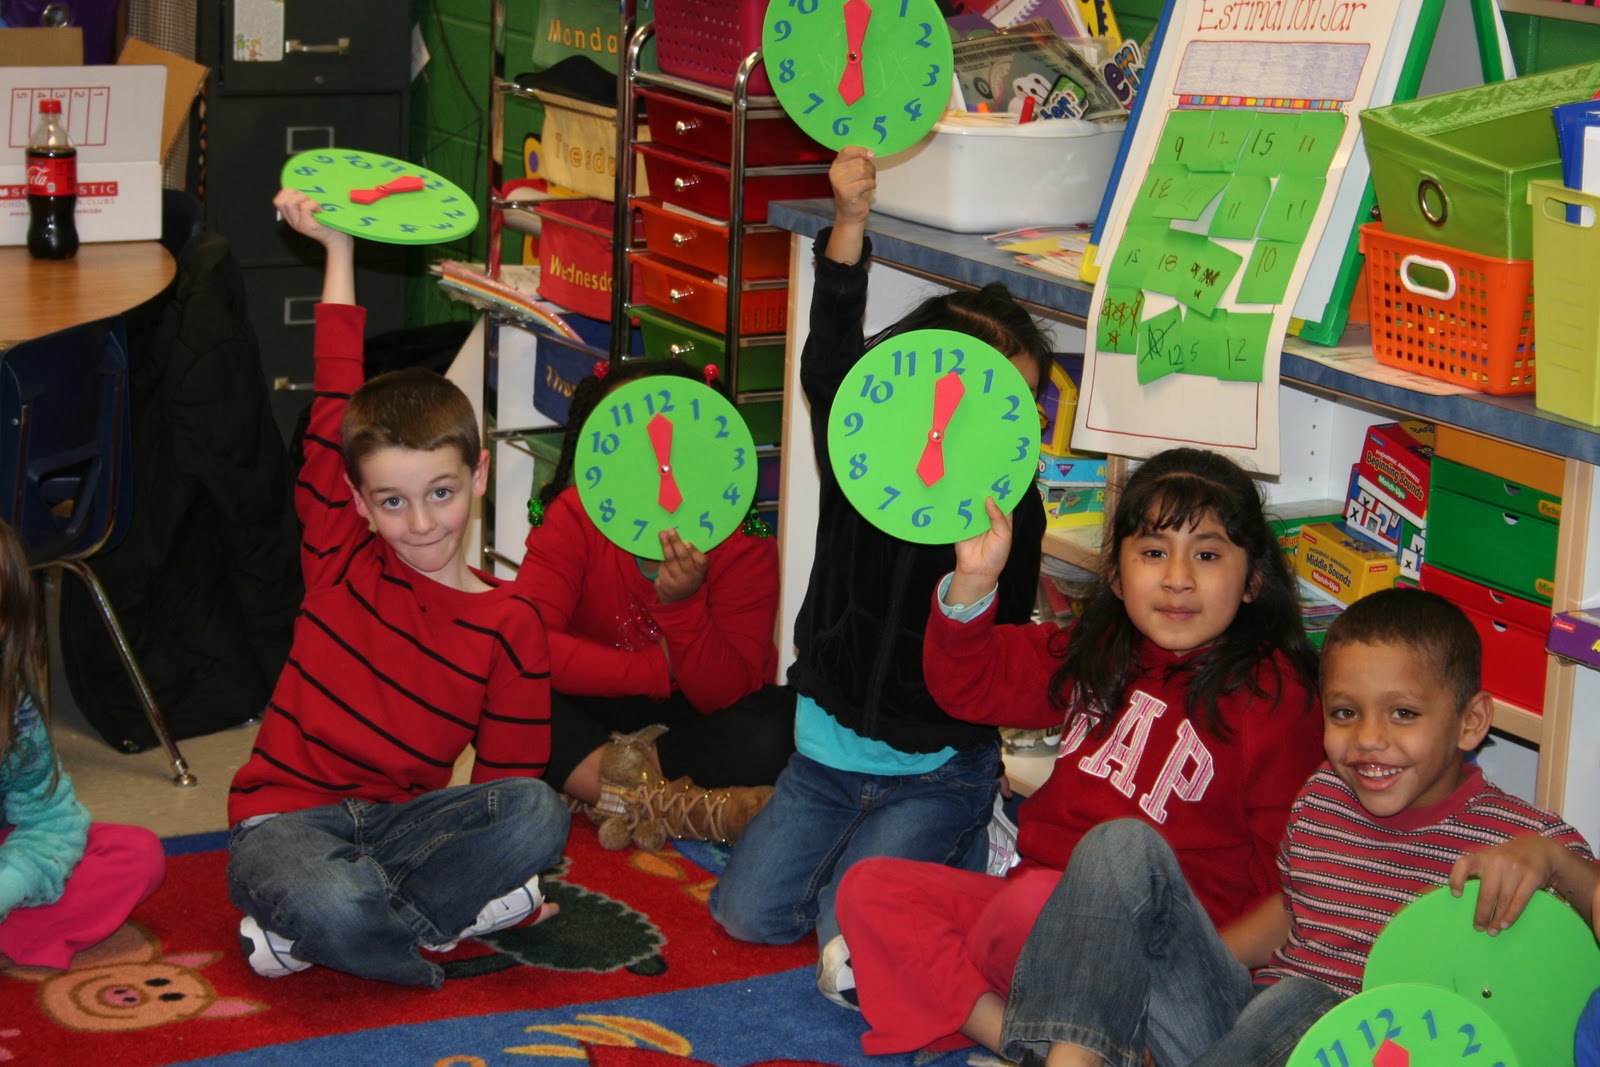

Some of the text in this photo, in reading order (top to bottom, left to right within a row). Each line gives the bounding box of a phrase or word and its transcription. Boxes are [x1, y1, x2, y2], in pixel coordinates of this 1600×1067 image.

[548, 19, 618, 54] Monda
[774, 20, 792, 42] 9
[914, 22, 932, 48] 2
[779, 59, 796, 84] 8
[922, 64, 941, 87] 3
[803, 93, 825, 115] 7
[903, 98, 923, 122] 4
[832, 117, 853, 137] 6
[872, 115, 887, 144] 5
[555, 132, 616, 176] Tuesda
[1174, 136, 1185, 162] 9
[1207, 131, 1231, 149] 12
[1251, 128, 1277, 156] 15
[293, 166, 319, 176] 8
[312, 155, 336, 164] 9
[343, 154, 374, 169] 10
[380, 160, 407, 173] 11
[299, 185, 327, 194] 7
[320, 203, 344, 212] 6
[442, 210, 466, 219] 2
[357, 216, 379, 227] 5
[400, 223, 420, 233] 4
[430, 222, 455, 230] 3
[550, 254, 612, 292] Wednesda
[1256, 247, 1277, 278] 10
[891, 350, 916, 377] 11
[932, 348, 966, 375] 12
[1226, 338, 1248, 370] 12
[859, 374, 894, 404] 10
[983, 369, 994, 394] 1
[610, 402, 634, 427] 11
[643, 390, 675, 416] 12
[690, 399, 700, 422] 1
[1001, 395, 1020, 422] 2
[715, 415, 730, 438] 2
[843, 412, 864, 437] 9
[592, 431, 620, 455] 10
[1011, 437, 1030, 461] 3
[732, 448, 745, 472] 3
[849, 453, 868, 480] 8
[585, 466, 602, 489] 9
[991, 474, 1012, 500] 4
[1366, 450, 1424, 501] Beginning Sounds
[1379, 474, 1406, 500] Match-Ups
[722, 482, 741, 506] 4
[877, 485, 902, 510] 7
[599, 498, 616, 523] 8
[911, 506, 934, 528] 6
[957, 498, 973, 530] 5
[632, 519, 649, 542] 7
[700, 511, 714, 538] 5
[1306, 552, 1352, 588] Middle Sounds
[1312, 571, 1340, 593] Match-Ups
[1356, 1008, 1402, 1050] 12
[1421, 1009, 1437, 1041] 1
[1457, 1023, 1482, 1057] 2
[1314, 1039, 1349, 1067] 11
